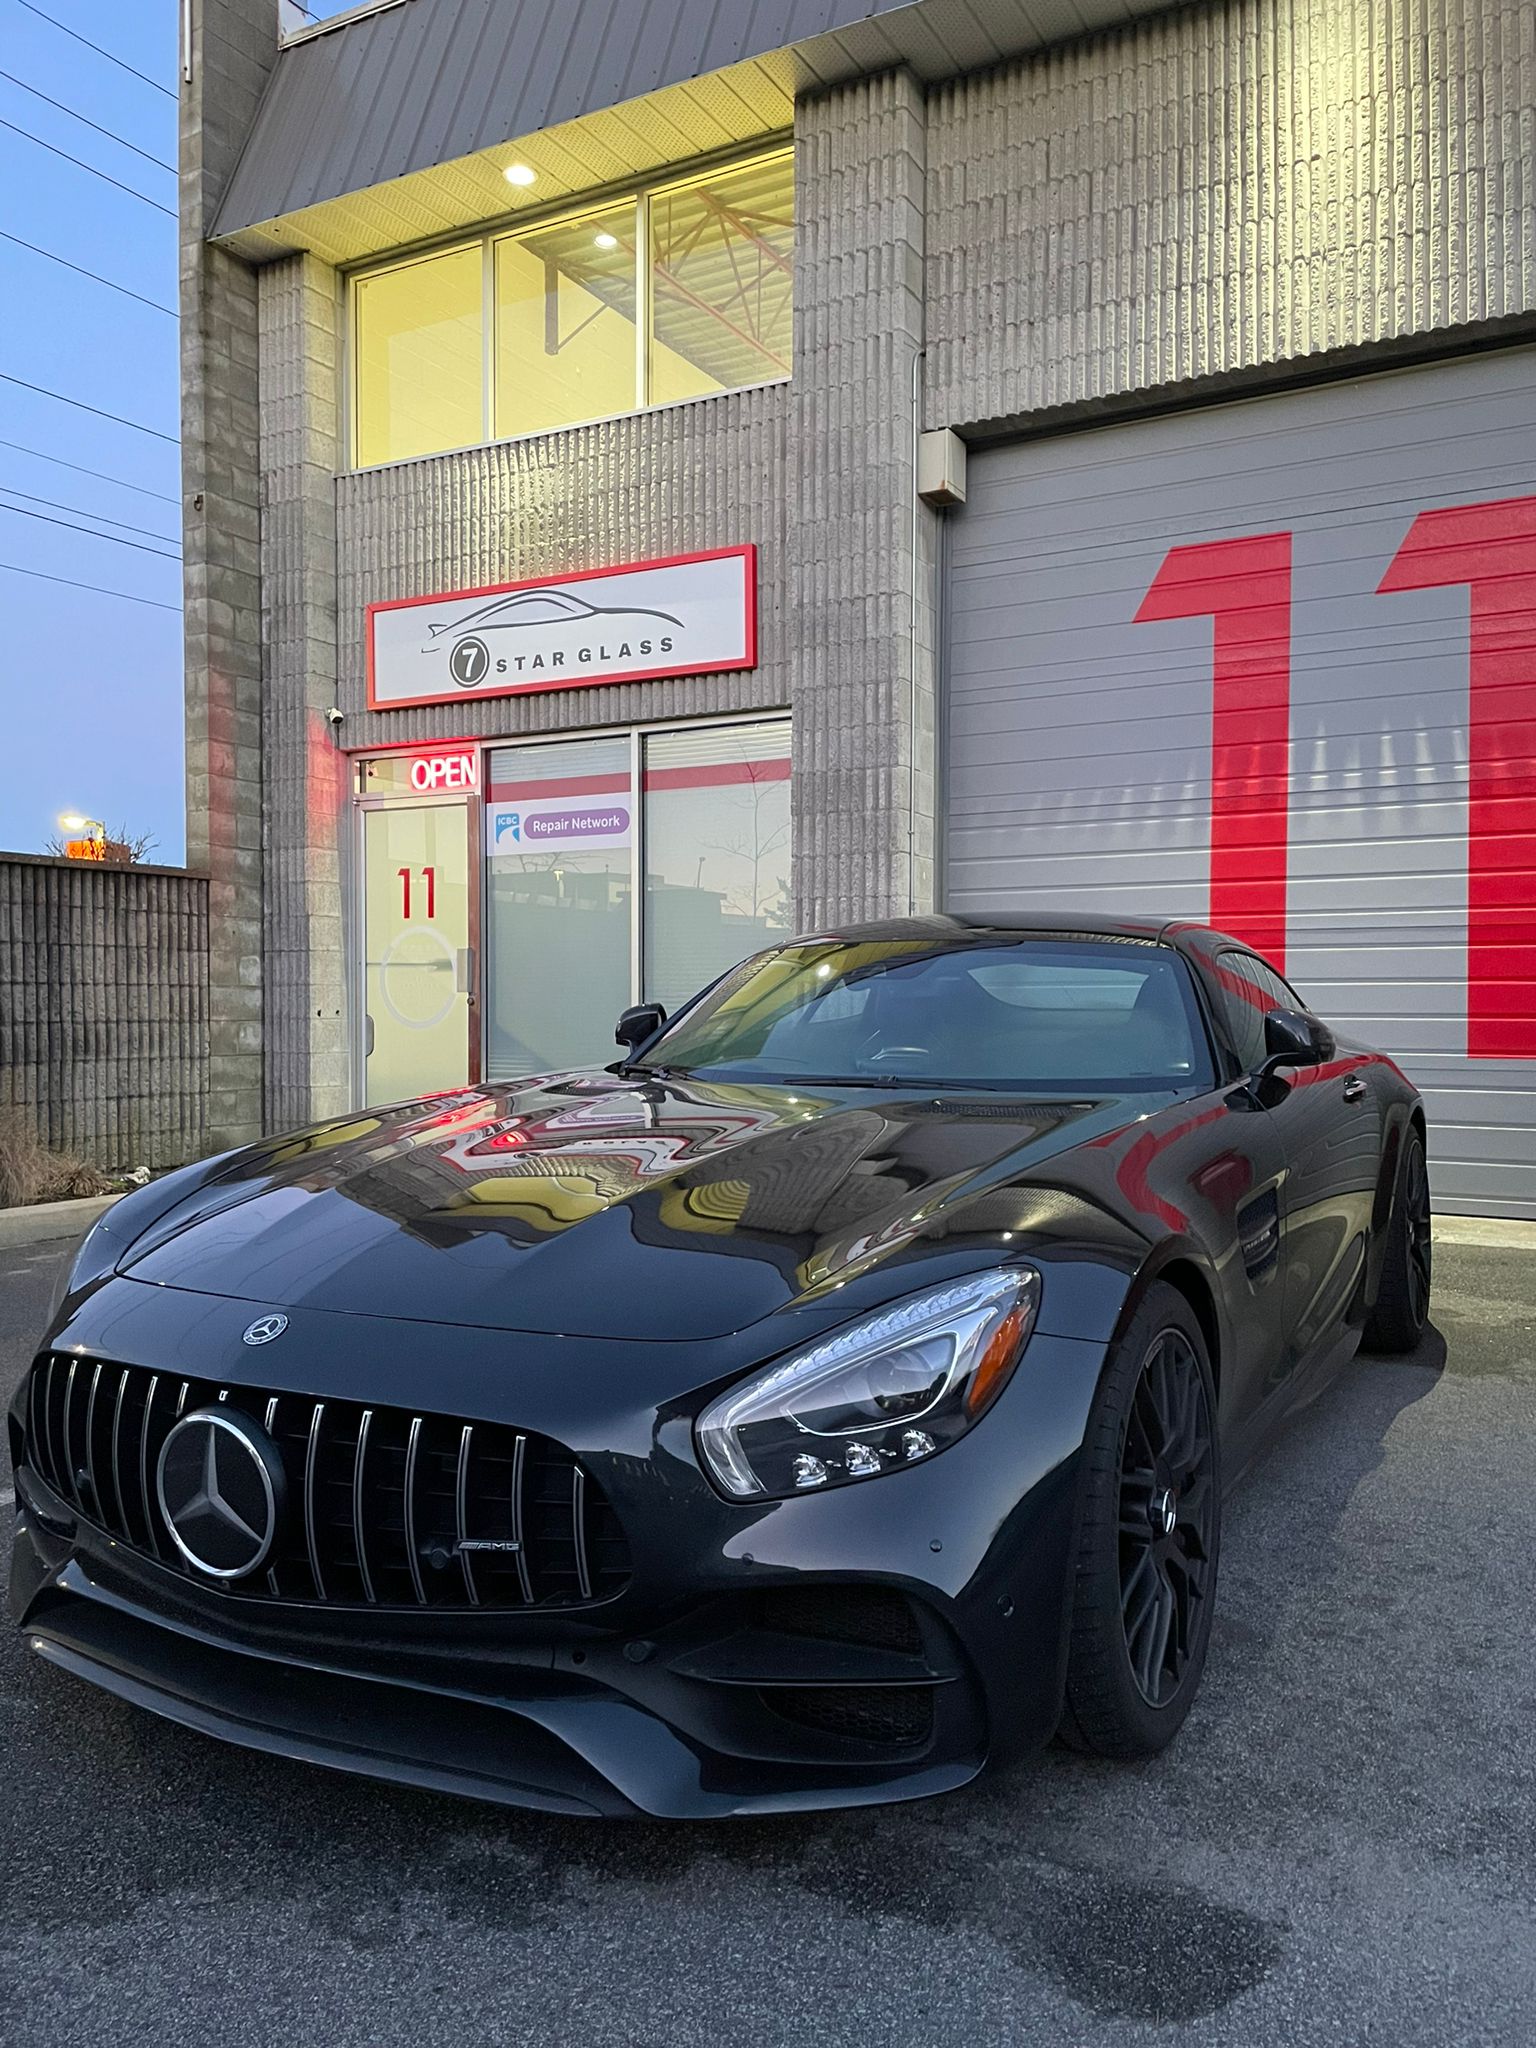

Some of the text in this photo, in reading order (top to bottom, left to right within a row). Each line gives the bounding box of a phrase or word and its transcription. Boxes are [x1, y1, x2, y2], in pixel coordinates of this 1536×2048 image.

[462, 637, 673, 678] 7 STAR GLASS
[411, 755, 477, 790] OPEN
[1132, 495, 1536, 1059] 11
[497, 815, 621, 834] ICBC Repair Network
[397, 867, 435, 919] 11
[477, 1542, 519, 1551] AMG
